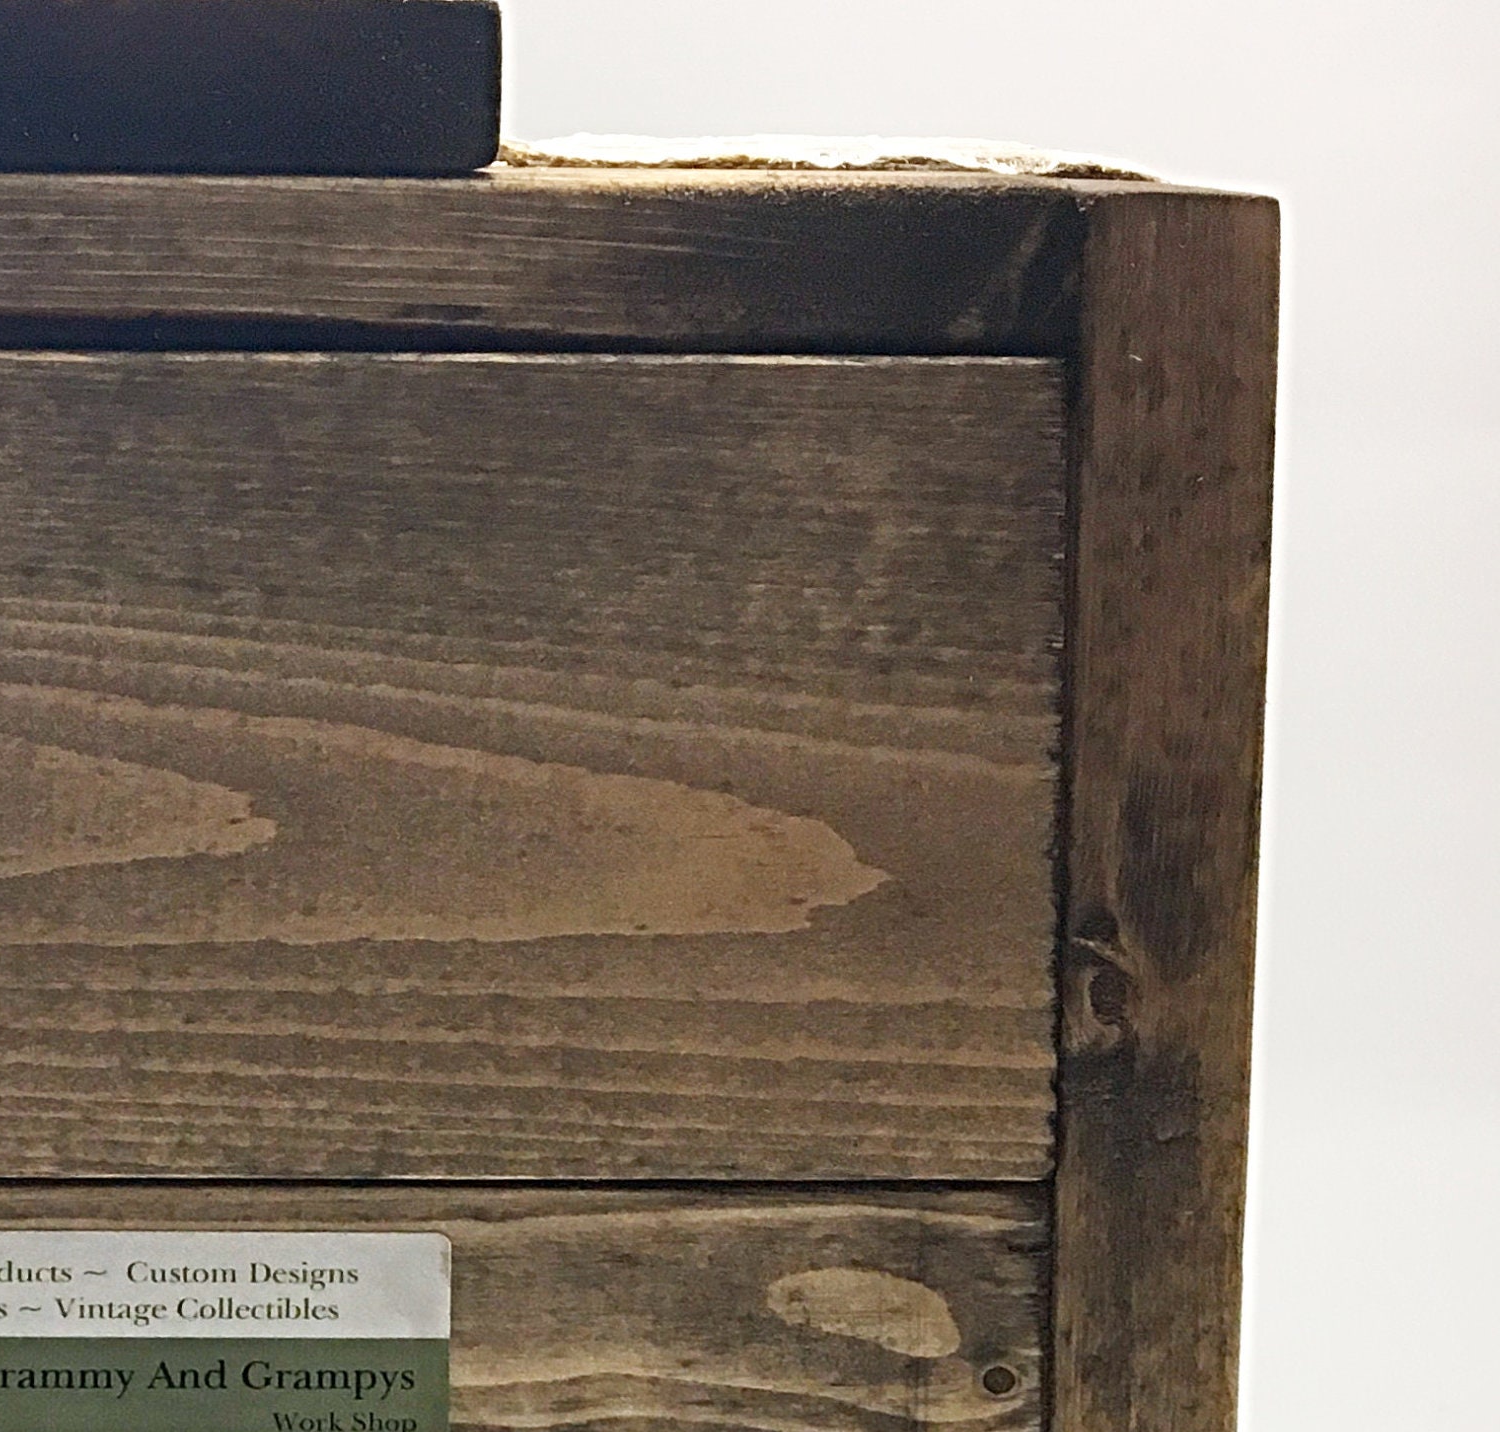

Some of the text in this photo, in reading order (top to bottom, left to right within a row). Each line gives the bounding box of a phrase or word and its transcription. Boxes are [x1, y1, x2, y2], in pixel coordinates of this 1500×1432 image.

[126, 1262, 237, 1284] Custom
[250, 1261, 359, 1288] Designs
[55, 1298, 167, 1325] Vintage
[176, 1297, 339, 1321] Collectibles
[147, 1359, 228, 1390] And
[241, 1360, 415, 1401] Grampys
[272, 1411, 344, 1432] Work
